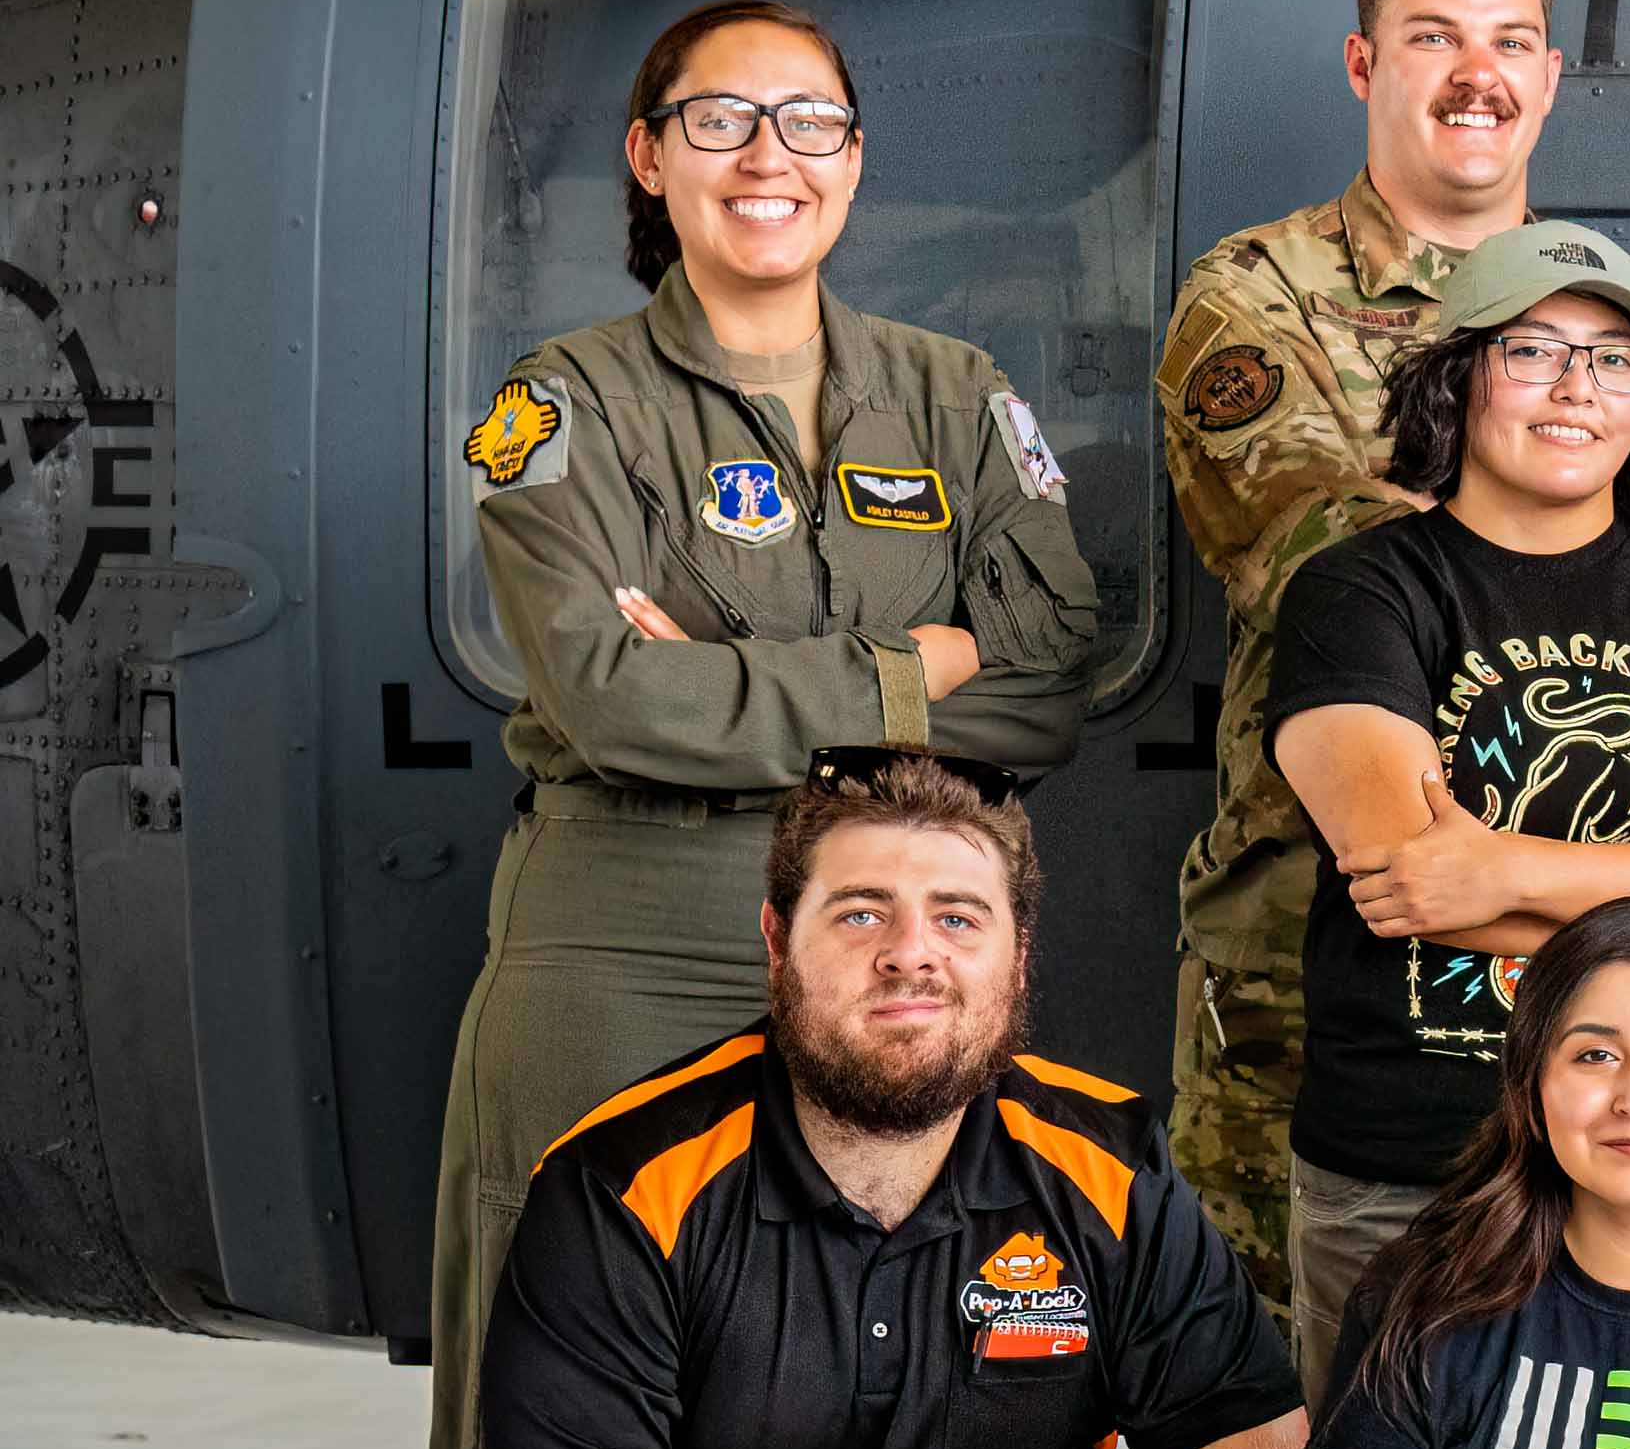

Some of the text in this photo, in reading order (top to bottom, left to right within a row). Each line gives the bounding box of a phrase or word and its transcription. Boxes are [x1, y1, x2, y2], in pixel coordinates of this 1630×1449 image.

[1556, 242, 1582, 251] THE
[1539, 249, 1584, 258] NORTH
[1553, 255, 1585, 267] FACE
[1436, 649, 1504, 801] KING
[968, 1290, 1077, 1312] Pop-A-Lock
